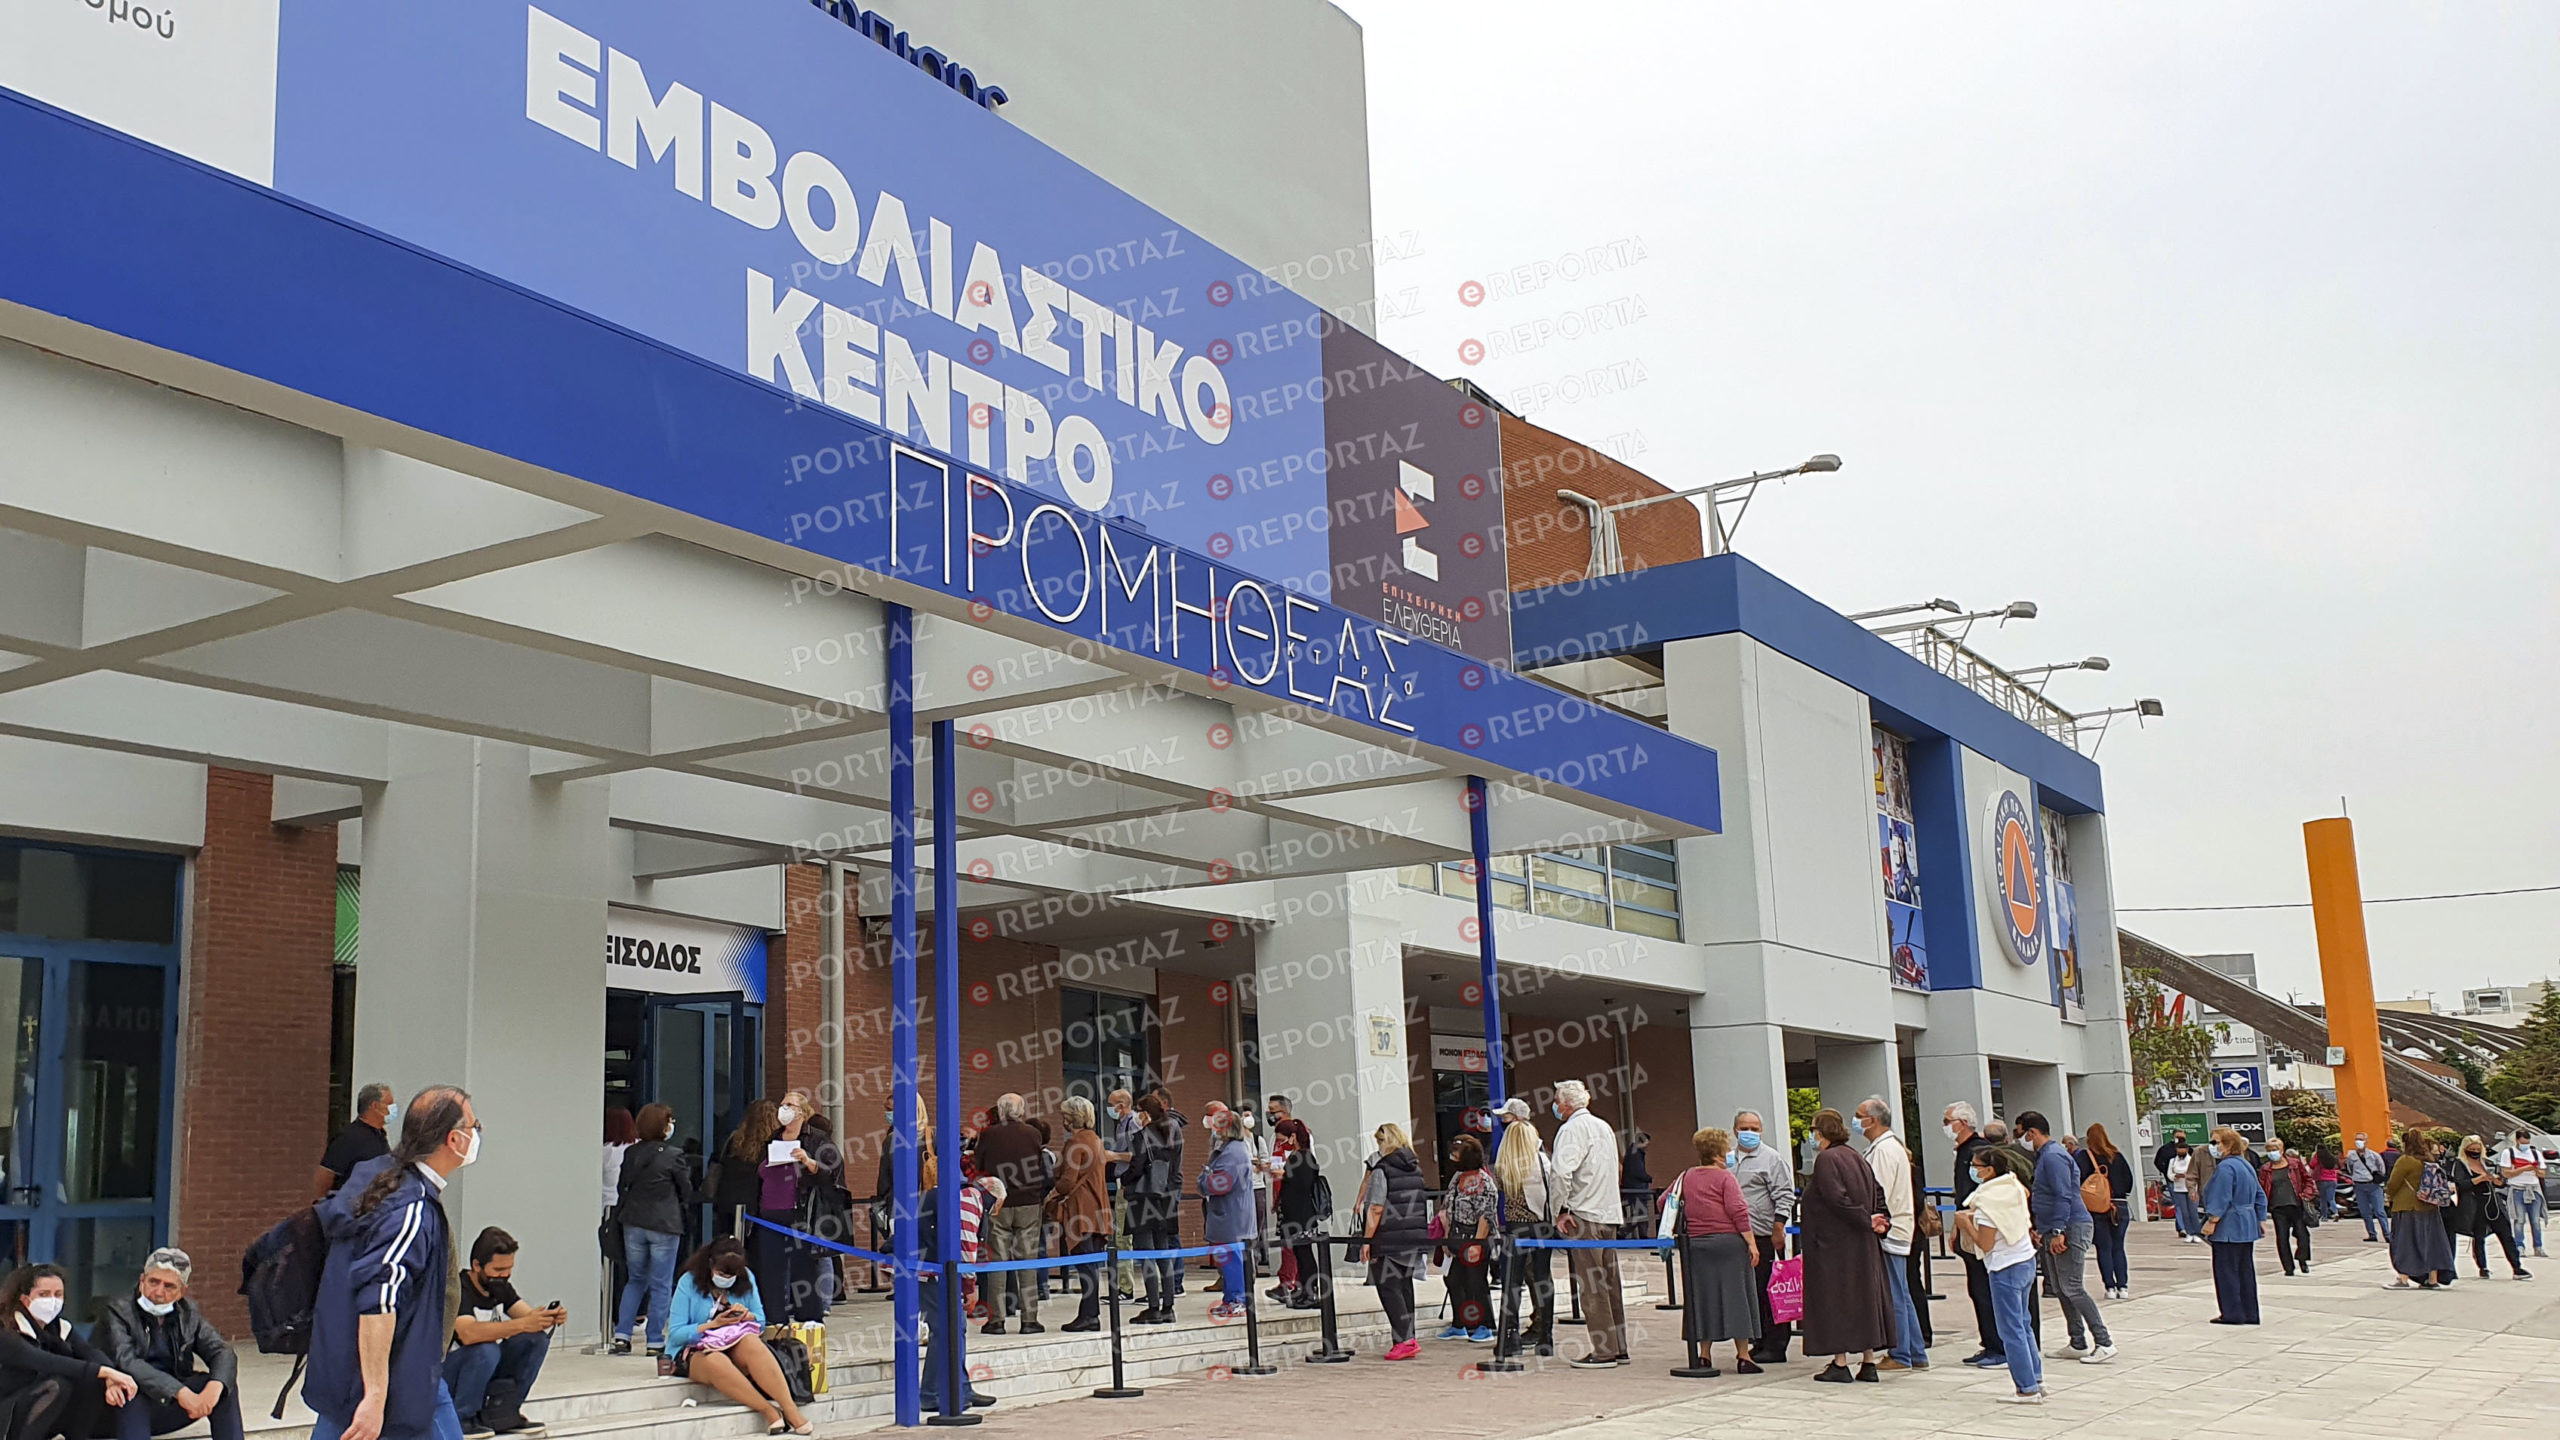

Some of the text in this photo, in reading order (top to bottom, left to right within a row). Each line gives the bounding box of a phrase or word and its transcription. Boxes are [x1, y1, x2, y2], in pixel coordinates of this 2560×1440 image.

[526, 4, 1232, 446] ΕΜΒΟΛΙΑΣΤΙΚΟ
[747, 267, 1113, 512] ΚΕΝΤΡΟ
[890, 442, 1415, 732] ΠΡΟΜΗΘΕΑΣ
[1382, 582, 1462, 624] ΕΠΙΧΕΙΡΗΣΗ
[1382, 598, 1463, 650] ΕΛΕΥΘΕΡΙΑ
[1377, 1031, 1391, 1051] 39
[2217, 1122, 2263, 1131] EOX
